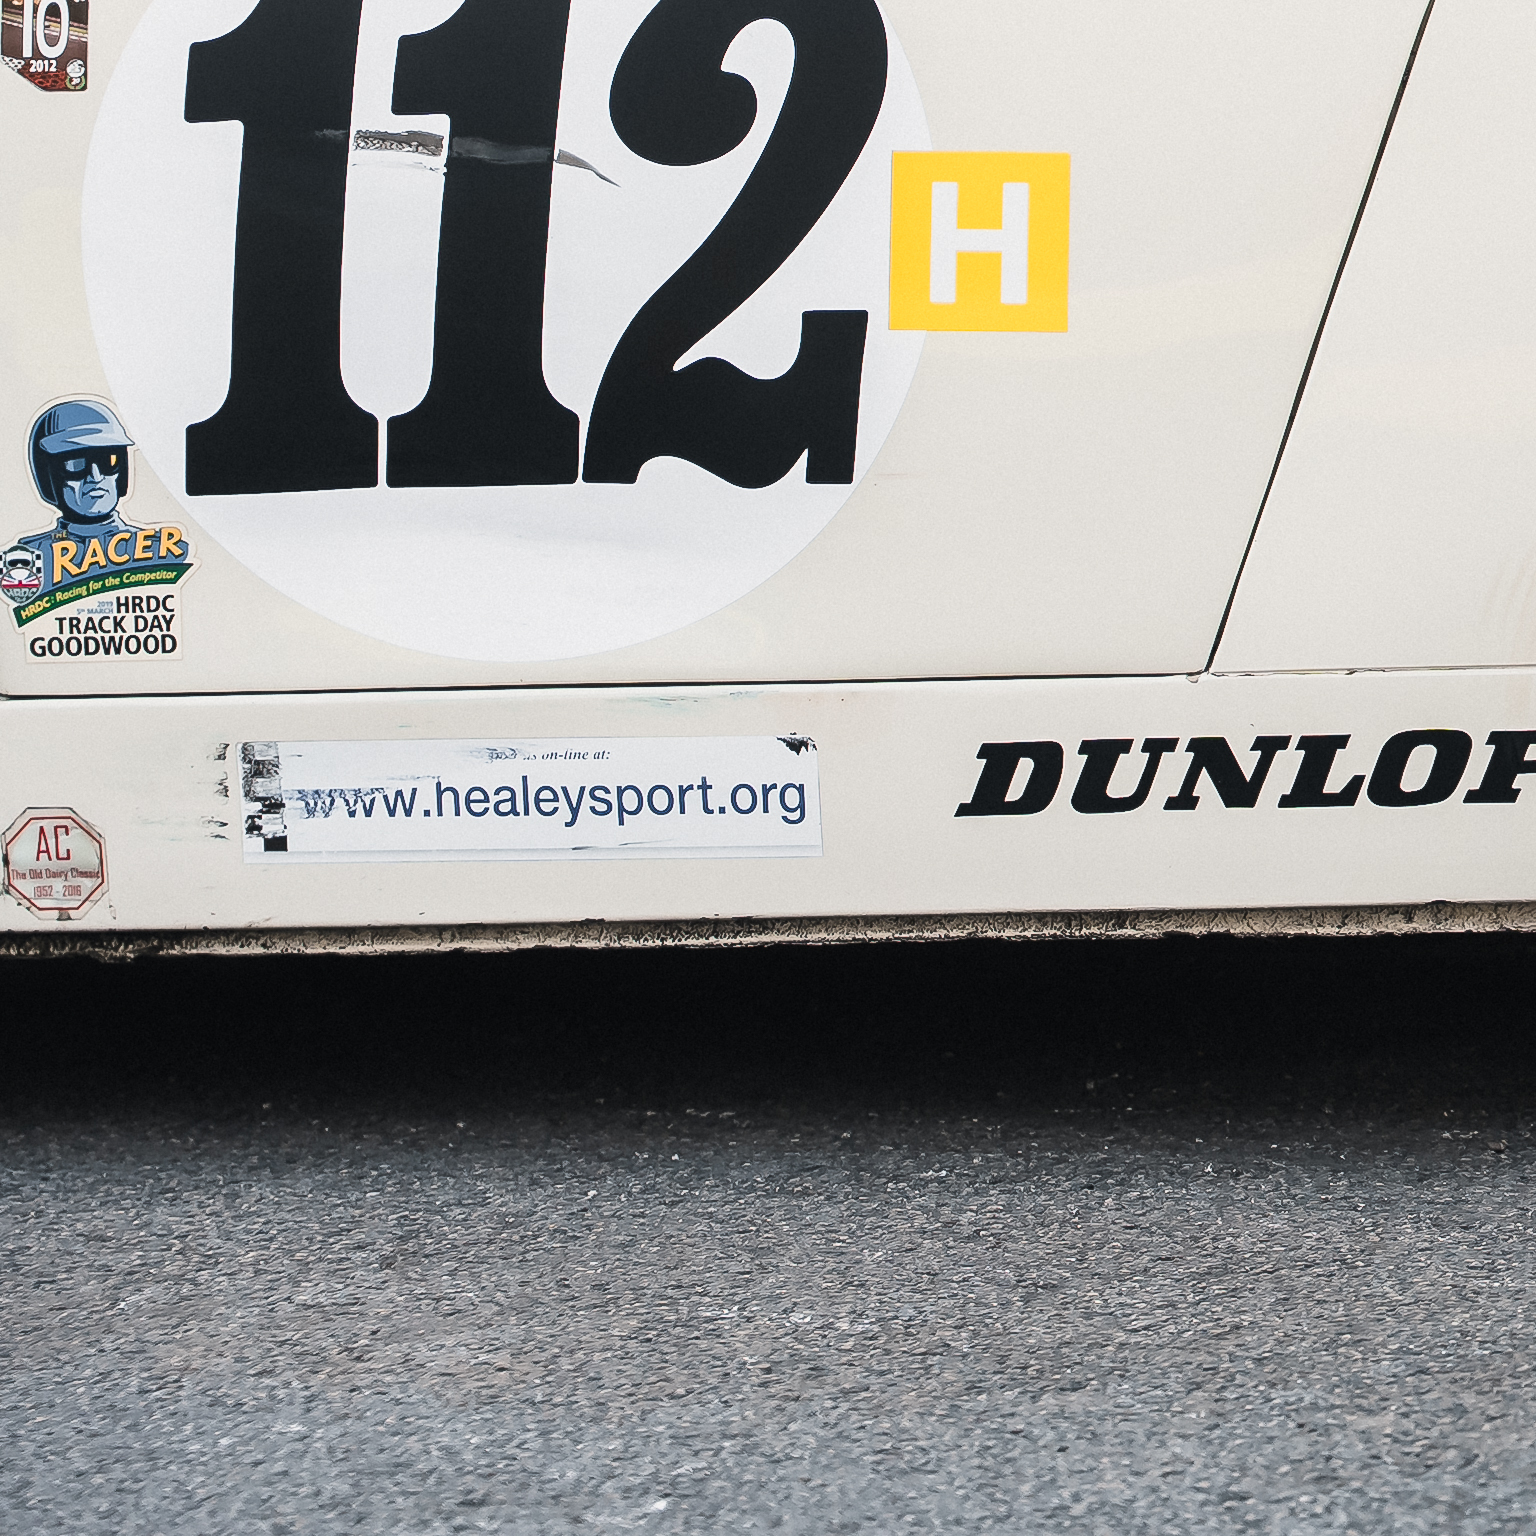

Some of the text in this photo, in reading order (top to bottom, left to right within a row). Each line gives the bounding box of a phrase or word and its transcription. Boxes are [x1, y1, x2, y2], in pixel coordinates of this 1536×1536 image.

[29, 59, 57, 73] 2012
[929, 181, 1031, 305] H
[52, 527, 184, 583] RACER
[55, 585, 87, 602] Racing
[89, 580, 103, 593] for
[105, 576, 120, 587] the
[122, 570, 178, 584] Competitor
[115, 594, 175, 614] HRDC
[55, 614, 176, 634] TRACK DAY
[29, 634, 178, 658] GOODWOOD
[541, 749, 589, 761] on-line
[593, 749, 611, 760] at:
[298, 775, 806, 826] www.healeysport.org
[36, 824, 71, 862] AC
[28, 868, 43, 880] Old
[45, 867, 69, 881] Dairy
[33, 885, 54, 897] 1952
[62, 884, 82, 897] 2016
